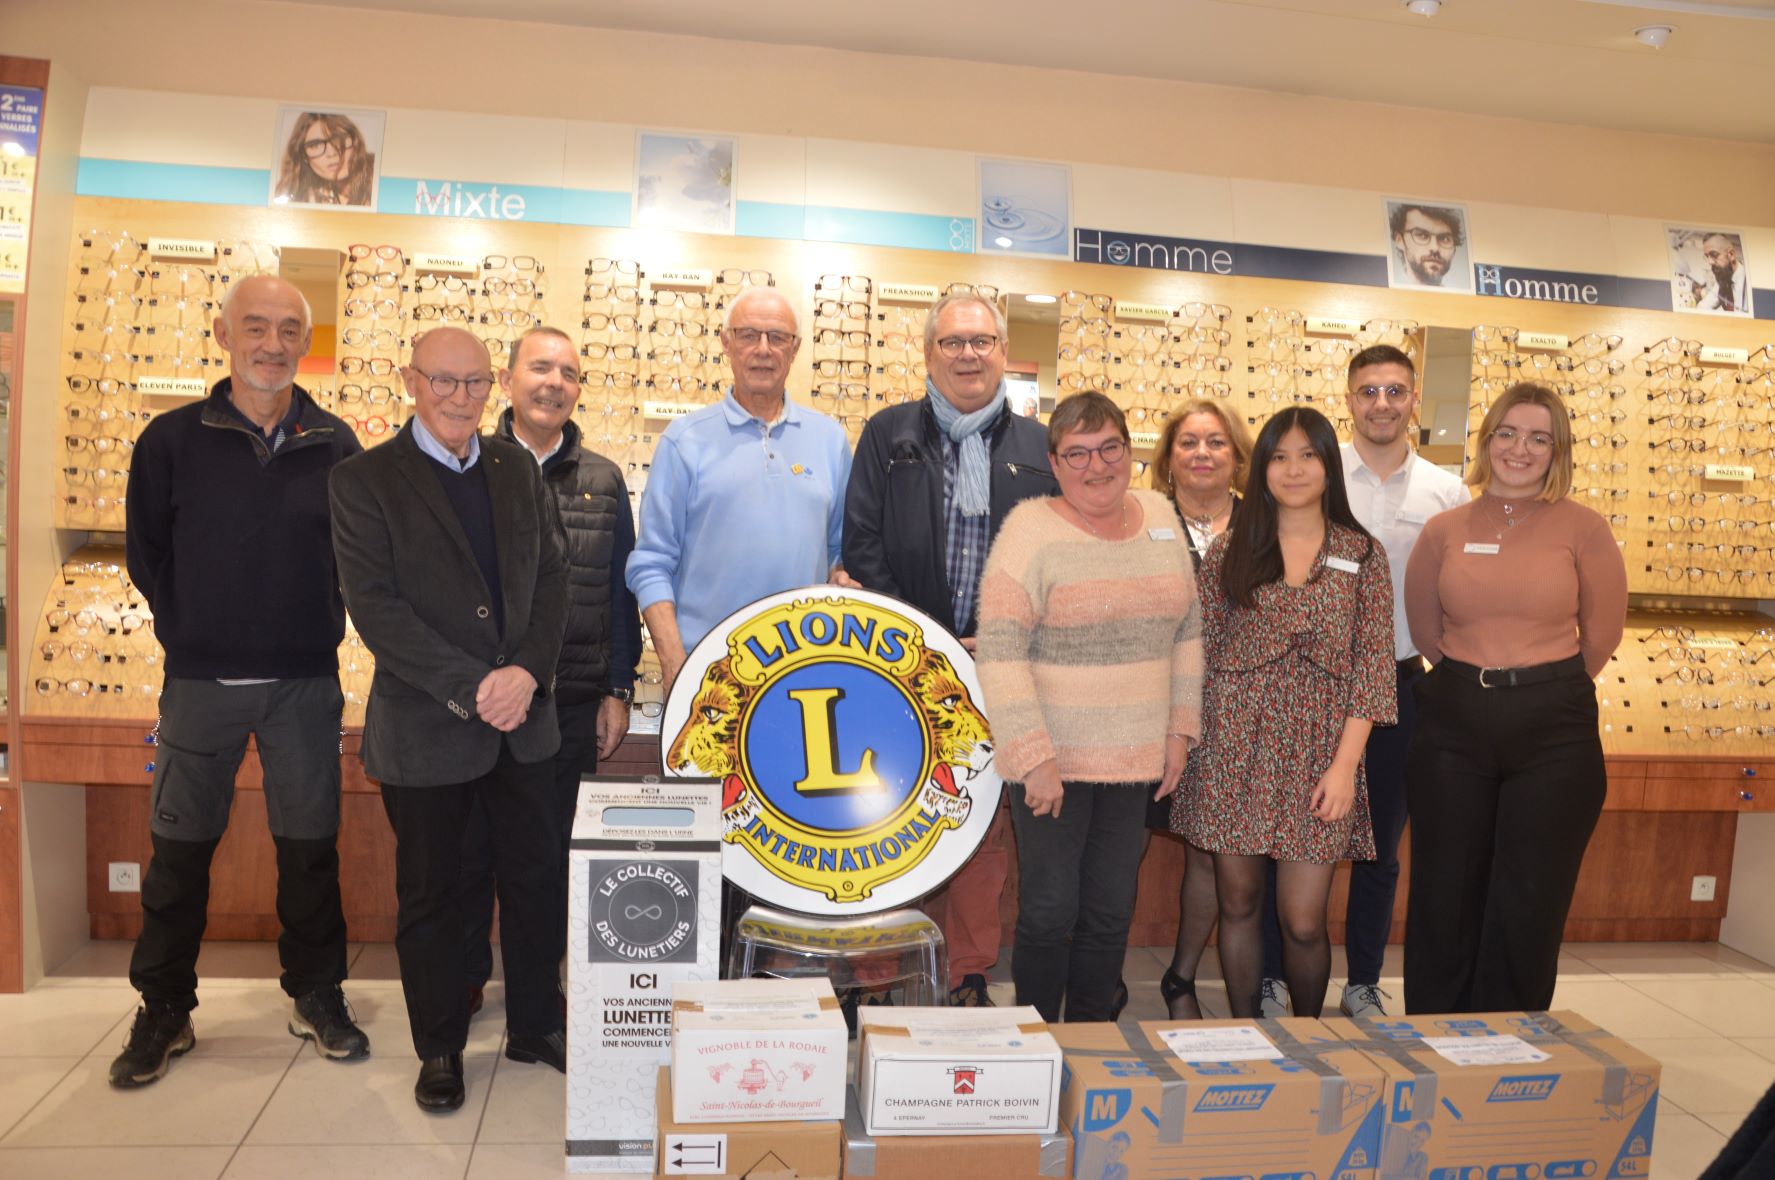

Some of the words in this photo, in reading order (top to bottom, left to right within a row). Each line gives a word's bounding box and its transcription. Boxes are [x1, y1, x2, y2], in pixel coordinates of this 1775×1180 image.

[415, 180, 526, 220] Mixte
[158, 243, 205, 253] INVISIBLE
[1076, 229, 1233, 274] Homme
[1477, 265, 1599, 304] Homme
[883, 288, 934, 297] FREAKSHOW
[1120, 306, 1143, 314] XAVIER
[1530, 337, 1557, 345] EXALTO
[139, 382, 173, 390] ELEVEN
[744, 611, 909, 668] LIONS
[788, 687, 885, 797] L
[743, 807, 942, 872] INTERNATIONAL
[599, 877, 618, 898] LE
[617, 863, 689, 899] COLLECTIF
[595, 920, 619, 948] DES
[617, 920, 690, 960] LUNETIERS
[630, 973, 657, 989] ICI
[603, 998, 625, 1007] VOS
[627, 998, 673, 1007] ANCIENN
[603, 1010, 672, 1024] LUNETTE
[603, 1028, 673, 1037] COMMENCE
[602, 1040, 619, 1048] UNE
[621, 1040, 663, 1048] NOUVELLE
[697, 1040, 751, 1055] VIGNOBLE
[755, 1040, 769, 1048] DE
[773, 1040, 785, 1048] LA
[789, 1041, 829, 1054] RODAIE
[1493, 1080, 1552, 1097] MOTTEZ
[885, 1098, 953, 1108] CHAMPAGNE
[956, 1099, 1000, 1108] PATRICK
[1004, 1098, 1040, 1107] BOIVIN
[1200, 1090, 1267, 1106] MOTTEZ
[1091, 1094, 1118, 1121] M
[618, 1142, 642, 1150] vision
